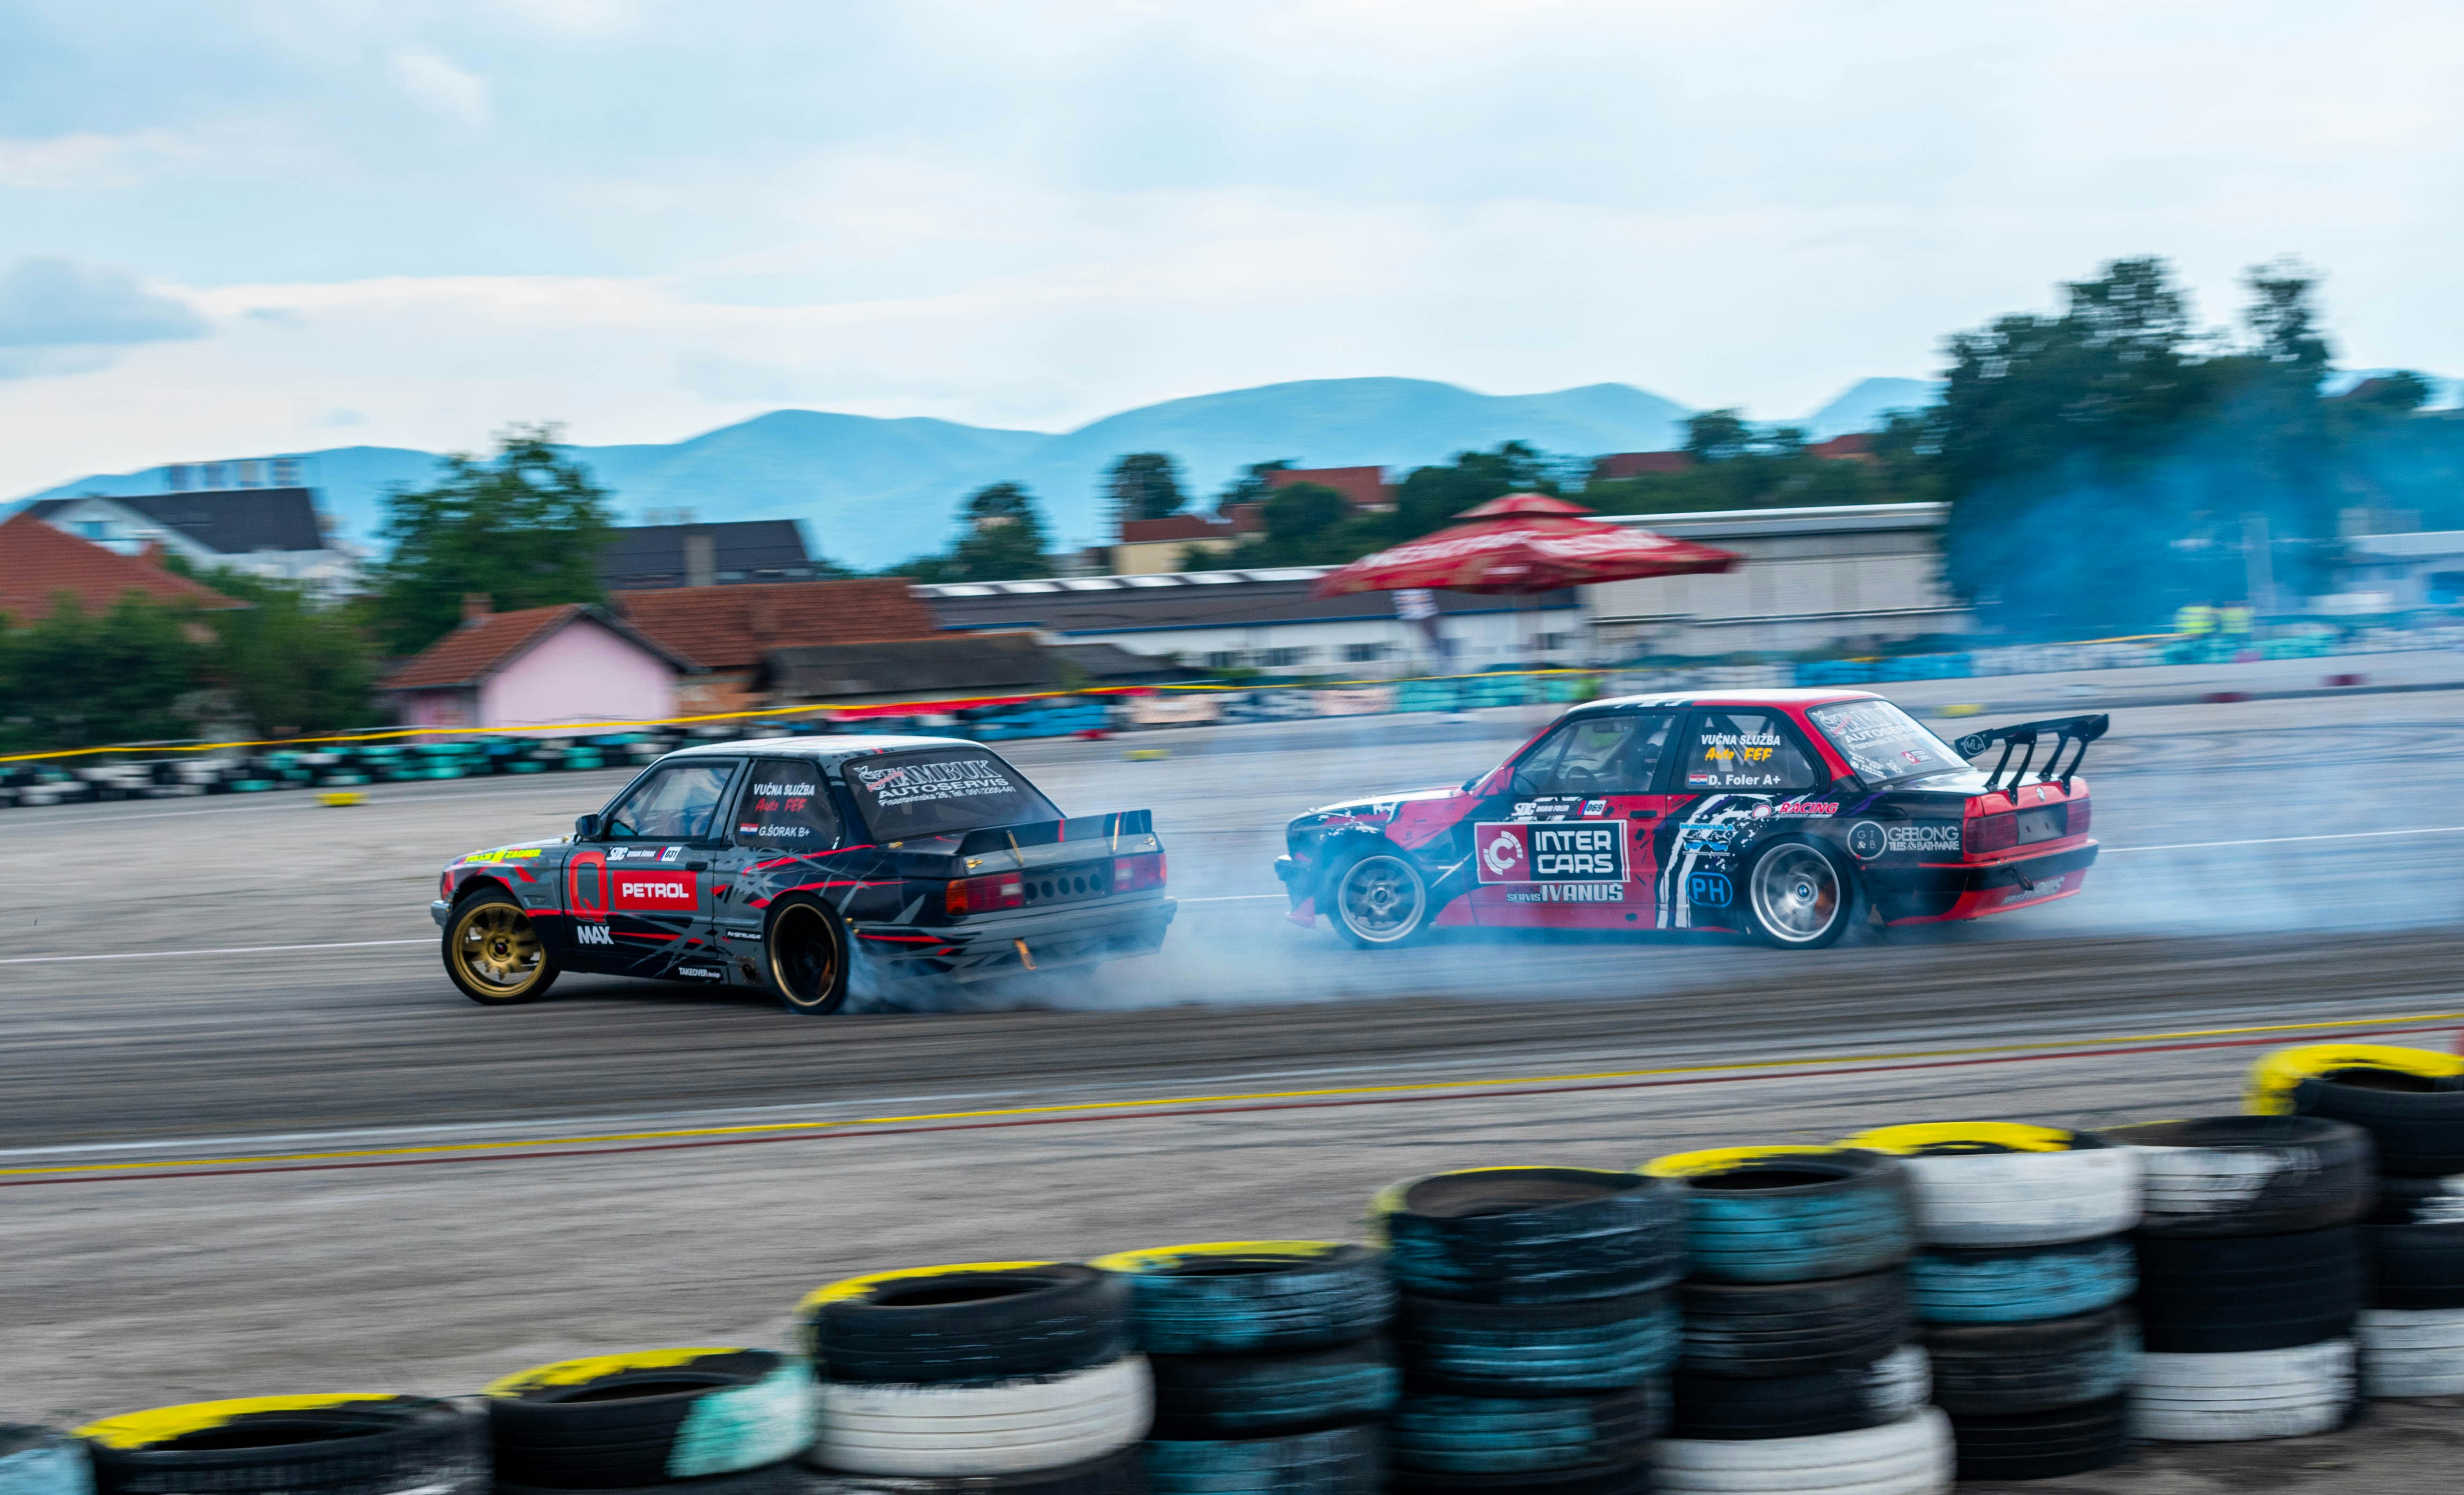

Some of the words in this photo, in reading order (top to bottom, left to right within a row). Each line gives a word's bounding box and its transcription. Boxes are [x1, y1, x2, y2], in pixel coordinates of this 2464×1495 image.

[1701, 733, 1736, 745] VUČNA
[1739, 733, 1781, 746] SLUŽBA
[1704, 747, 1735, 761] Auto
[1744, 747, 1773, 762] FEF
[853, 760, 1002, 790] ŠTAMBUK
[1708, 775, 1721, 785] D.
[1725, 774, 1760, 785] Foler
[1762, 774, 1781, 785] A+
[754, 782, 782, 796] VUČNA
[783, 782, 815, 796] SLUŽBA
[878, 778, 1009, 799] AUTOSERVIS
[755, 798, 779, 812] Auto
[784, 798, 807, 813] FEF
[1586, 803, 1604, 812] 069
[1779, 802, 1839, 814] RACING
[759, 824, 797, 837] G.ŠORAK
[798, 826, 811, 837] B+
[1857, 830, 1866, 839] G
[1888, 826, 1959, 841] GEELONG
[1535, 830, 1612, 852] INTER
[1889, 841, 1907, 851] TILES
[1917, 840, 1960, 851] BATHWARE
[665, 850, 678, 858] 031
[1537, 853, 1614, 874] CARS
[568, 850, 608, 923] Q
[622, 883, 689, 898] PETROL
[1507, 893, 1541, 902] SERVIS
[1541, 882, 1624, 902] IVANUŠ
[1691, 877, 1725, 903] PH
[577, 926, 614, 944] MAX
